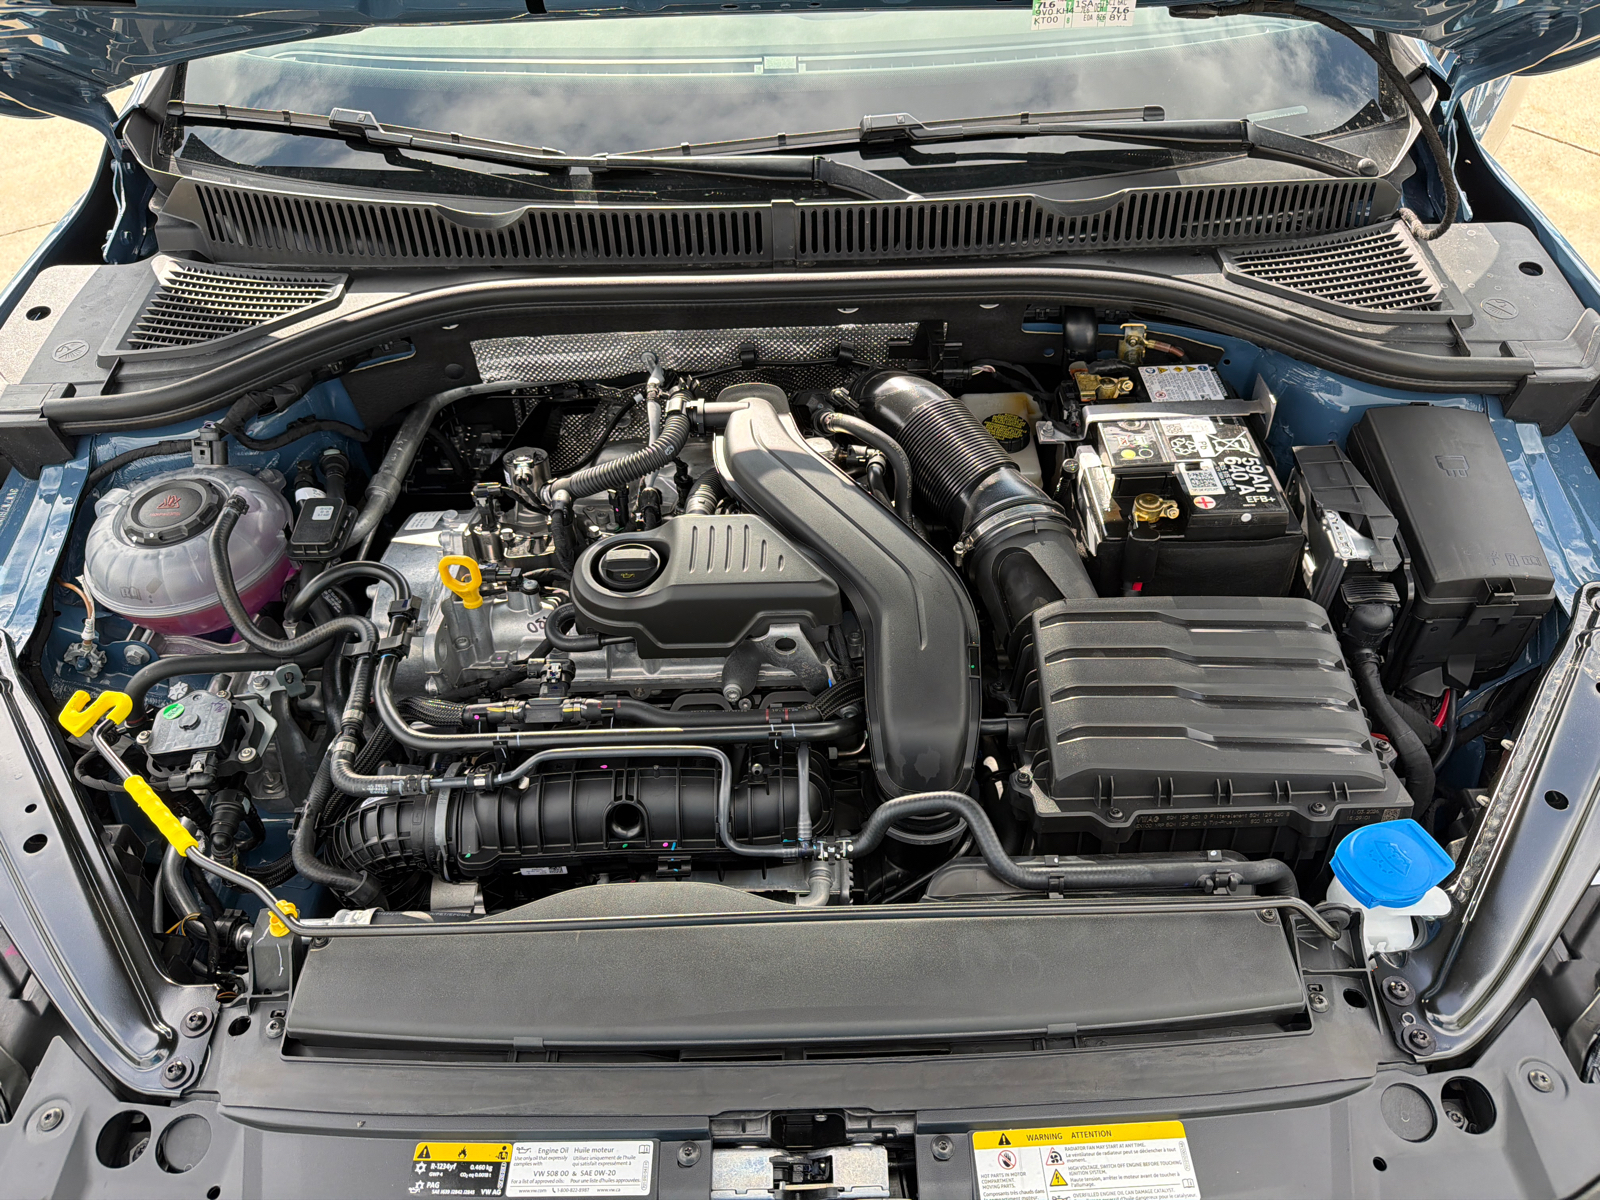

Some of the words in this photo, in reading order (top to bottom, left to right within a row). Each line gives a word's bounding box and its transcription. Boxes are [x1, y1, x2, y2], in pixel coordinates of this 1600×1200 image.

[1224, 457, 1250, 481] 640
[1242, 457, 1272, 493] 59Ah
[1236, 484, 1256, 495] A
[1026, 1133, 1063, 1141] WARNING
[1071, 1130, 1112, 1139] ATTENTION
[538, 1147, 559, 1155] Engine
[430, 1163, 457, 1172] R-1234yf
